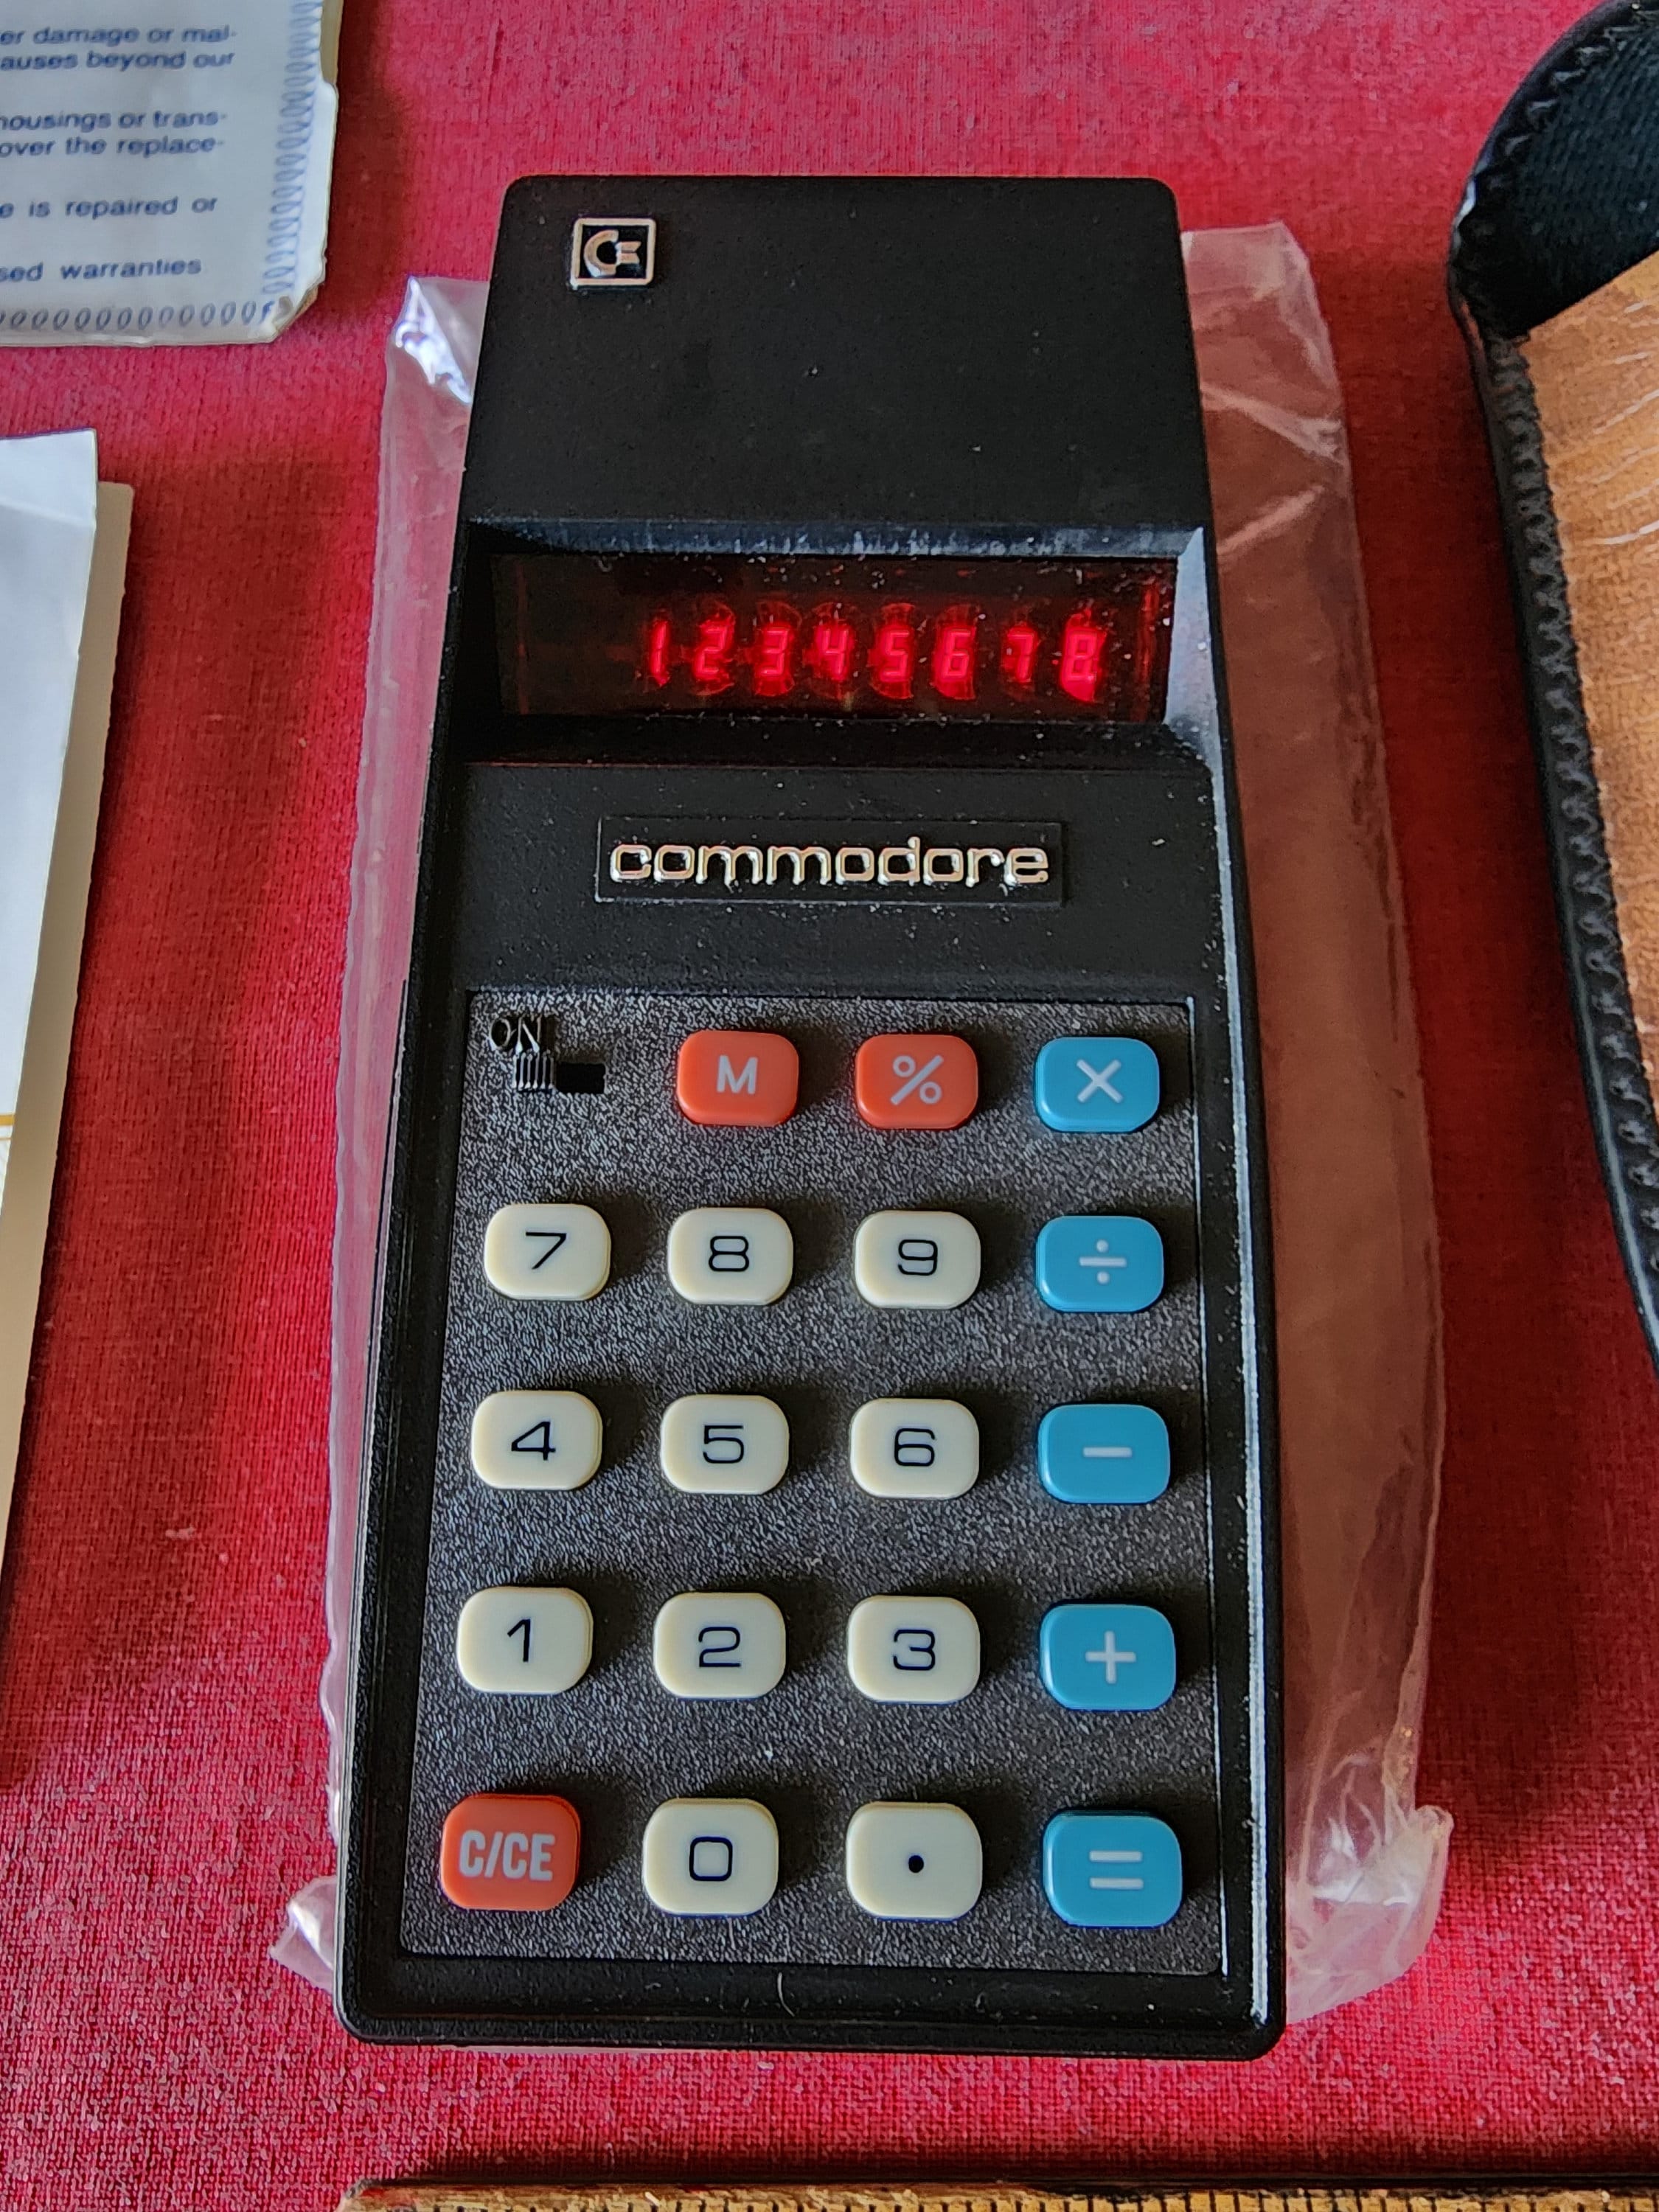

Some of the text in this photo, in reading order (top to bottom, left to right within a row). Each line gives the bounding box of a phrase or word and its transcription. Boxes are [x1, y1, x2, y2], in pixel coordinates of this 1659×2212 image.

[33, 27, 140, 46] damage
[147, 28, 173, 43] or
[181, 25, 237, 43] mal-
[86, 51, 186, 72] beyond
[193, 52, 235, 68] our
[118, 113, 145, 128] or
[153, 111, 227, 128] trans-
[66, 136, 106, 155] the
[116, 136, 224, 158] replace-
[29, 201, 50, 218] is
[66, 196, 178, 220] repaired
[192, 197, 217, 213] or
[60, 258, 201, 279] warranties
[610, 836, 1049, 886] commodore
[488, 1016, 542, 1054] ON
[717, 1055, 758, 1095] M
[890, 1055, 944, 1106] %
[525, 1231, 567, 1270] 7
[708, 1235, 750, 1273] 8
[897, 1239, 939, 1276] 9
[511, 1421, 556, 1461] 4
[702, 1425, 745, 1464] 5
[894, 1427, 936, 1467] 6
[507, 1618, 532, 1663] 1
[698, 1626, 742, 1669] 2
[893, 1629, 936, 1672] 3
[459, 1829, 556, 1882] C/CE
[689, 1837, 734, 1882] 0
